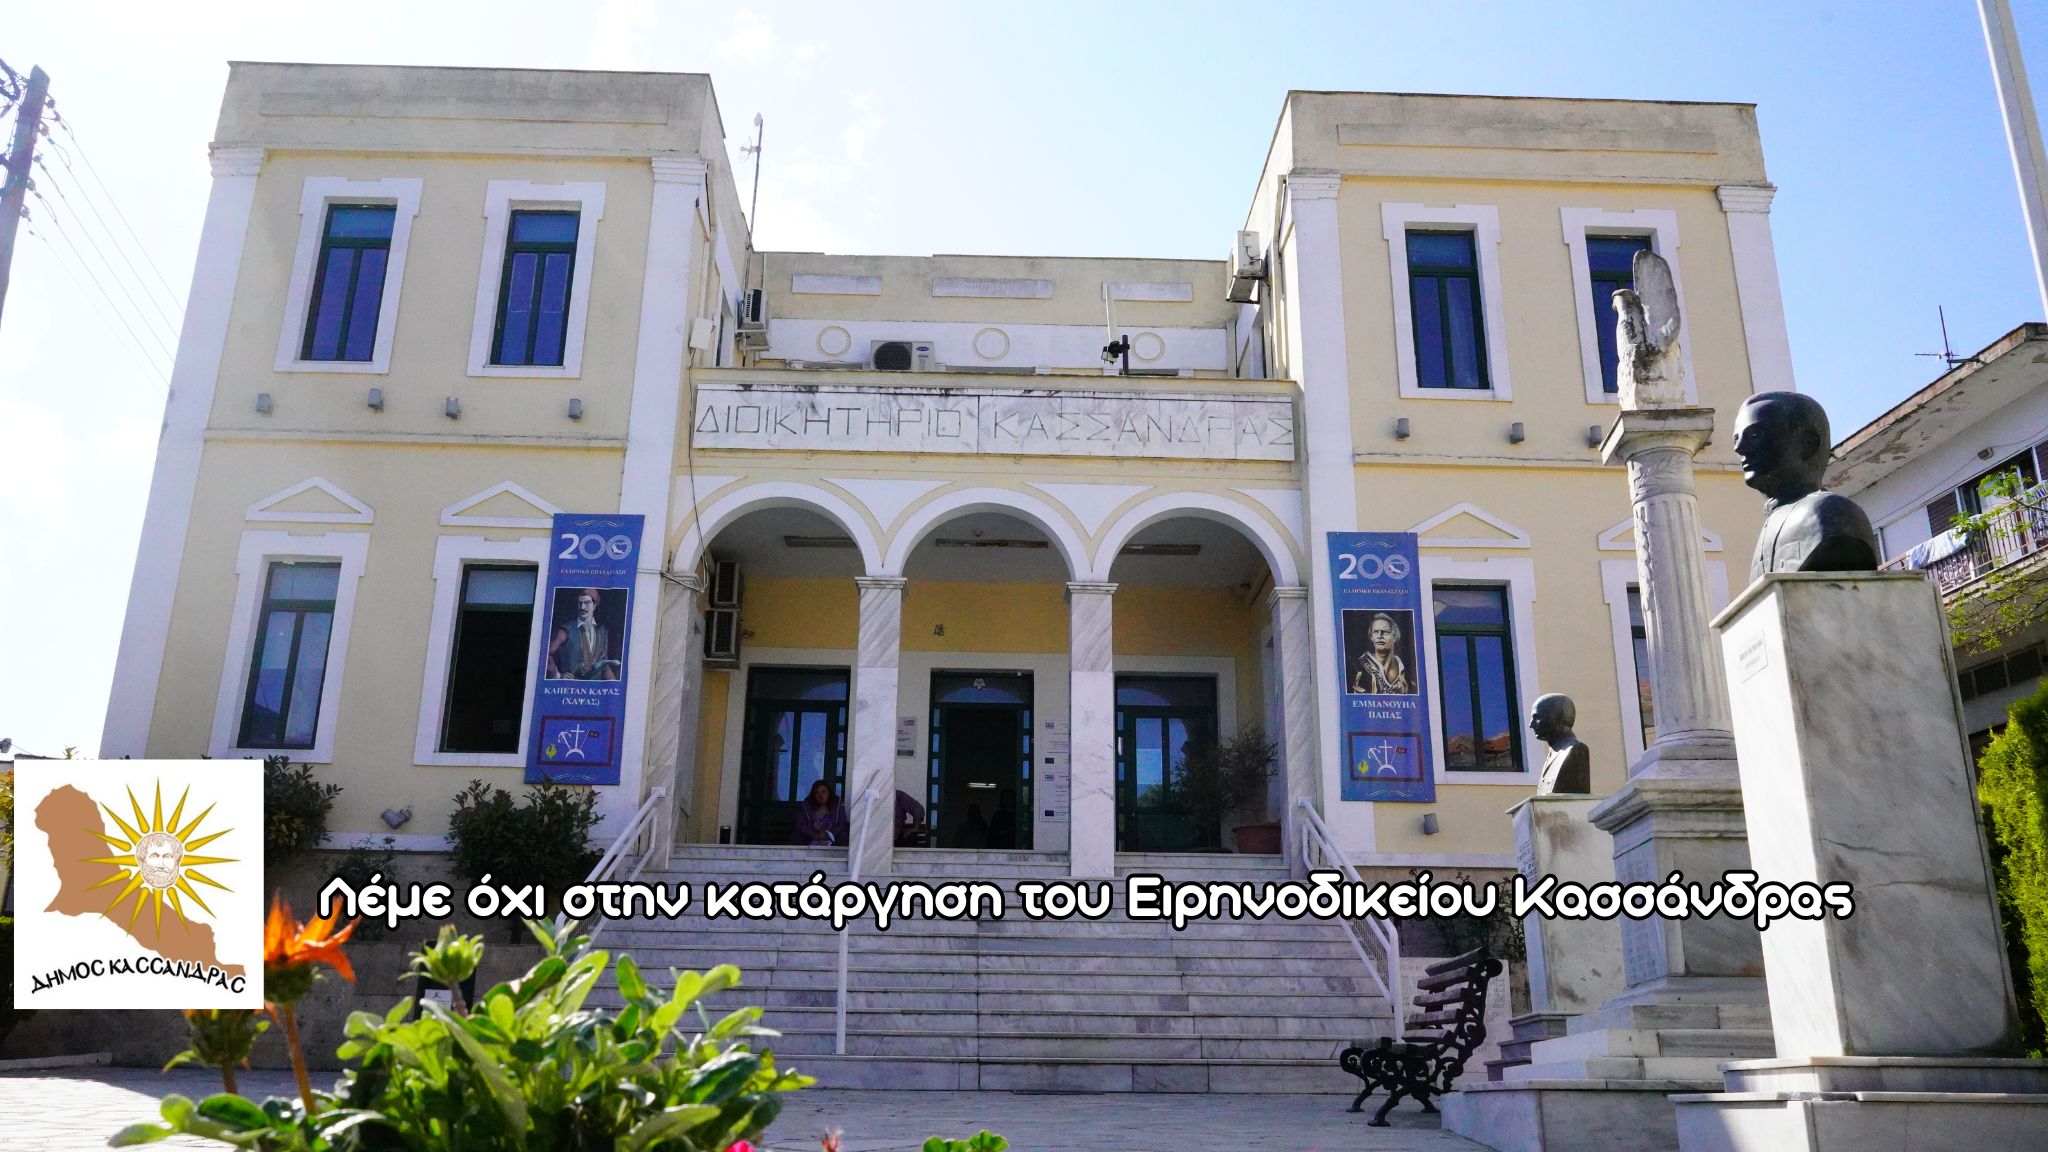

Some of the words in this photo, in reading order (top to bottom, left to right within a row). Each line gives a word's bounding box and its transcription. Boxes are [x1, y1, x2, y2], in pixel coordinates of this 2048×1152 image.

[696, 405, 962, 437] ΔΙΟΙΚΗΤΗΡΙΟ
[994, 411, 1293, 445] ΚΑΣΣΑΝΔΡΑΣ
[559, 533, 633, 560] 200
[1339, 554, 1411, 580] 200
[544, 687, 587, 695] ΚΑΠΕΤΑΝ
[1352, 700, 1417, 709] ΕΜΜΑΝΟΥΗΛ
[1368, 711, 1402, 719] ΠΑΠΑΣ
